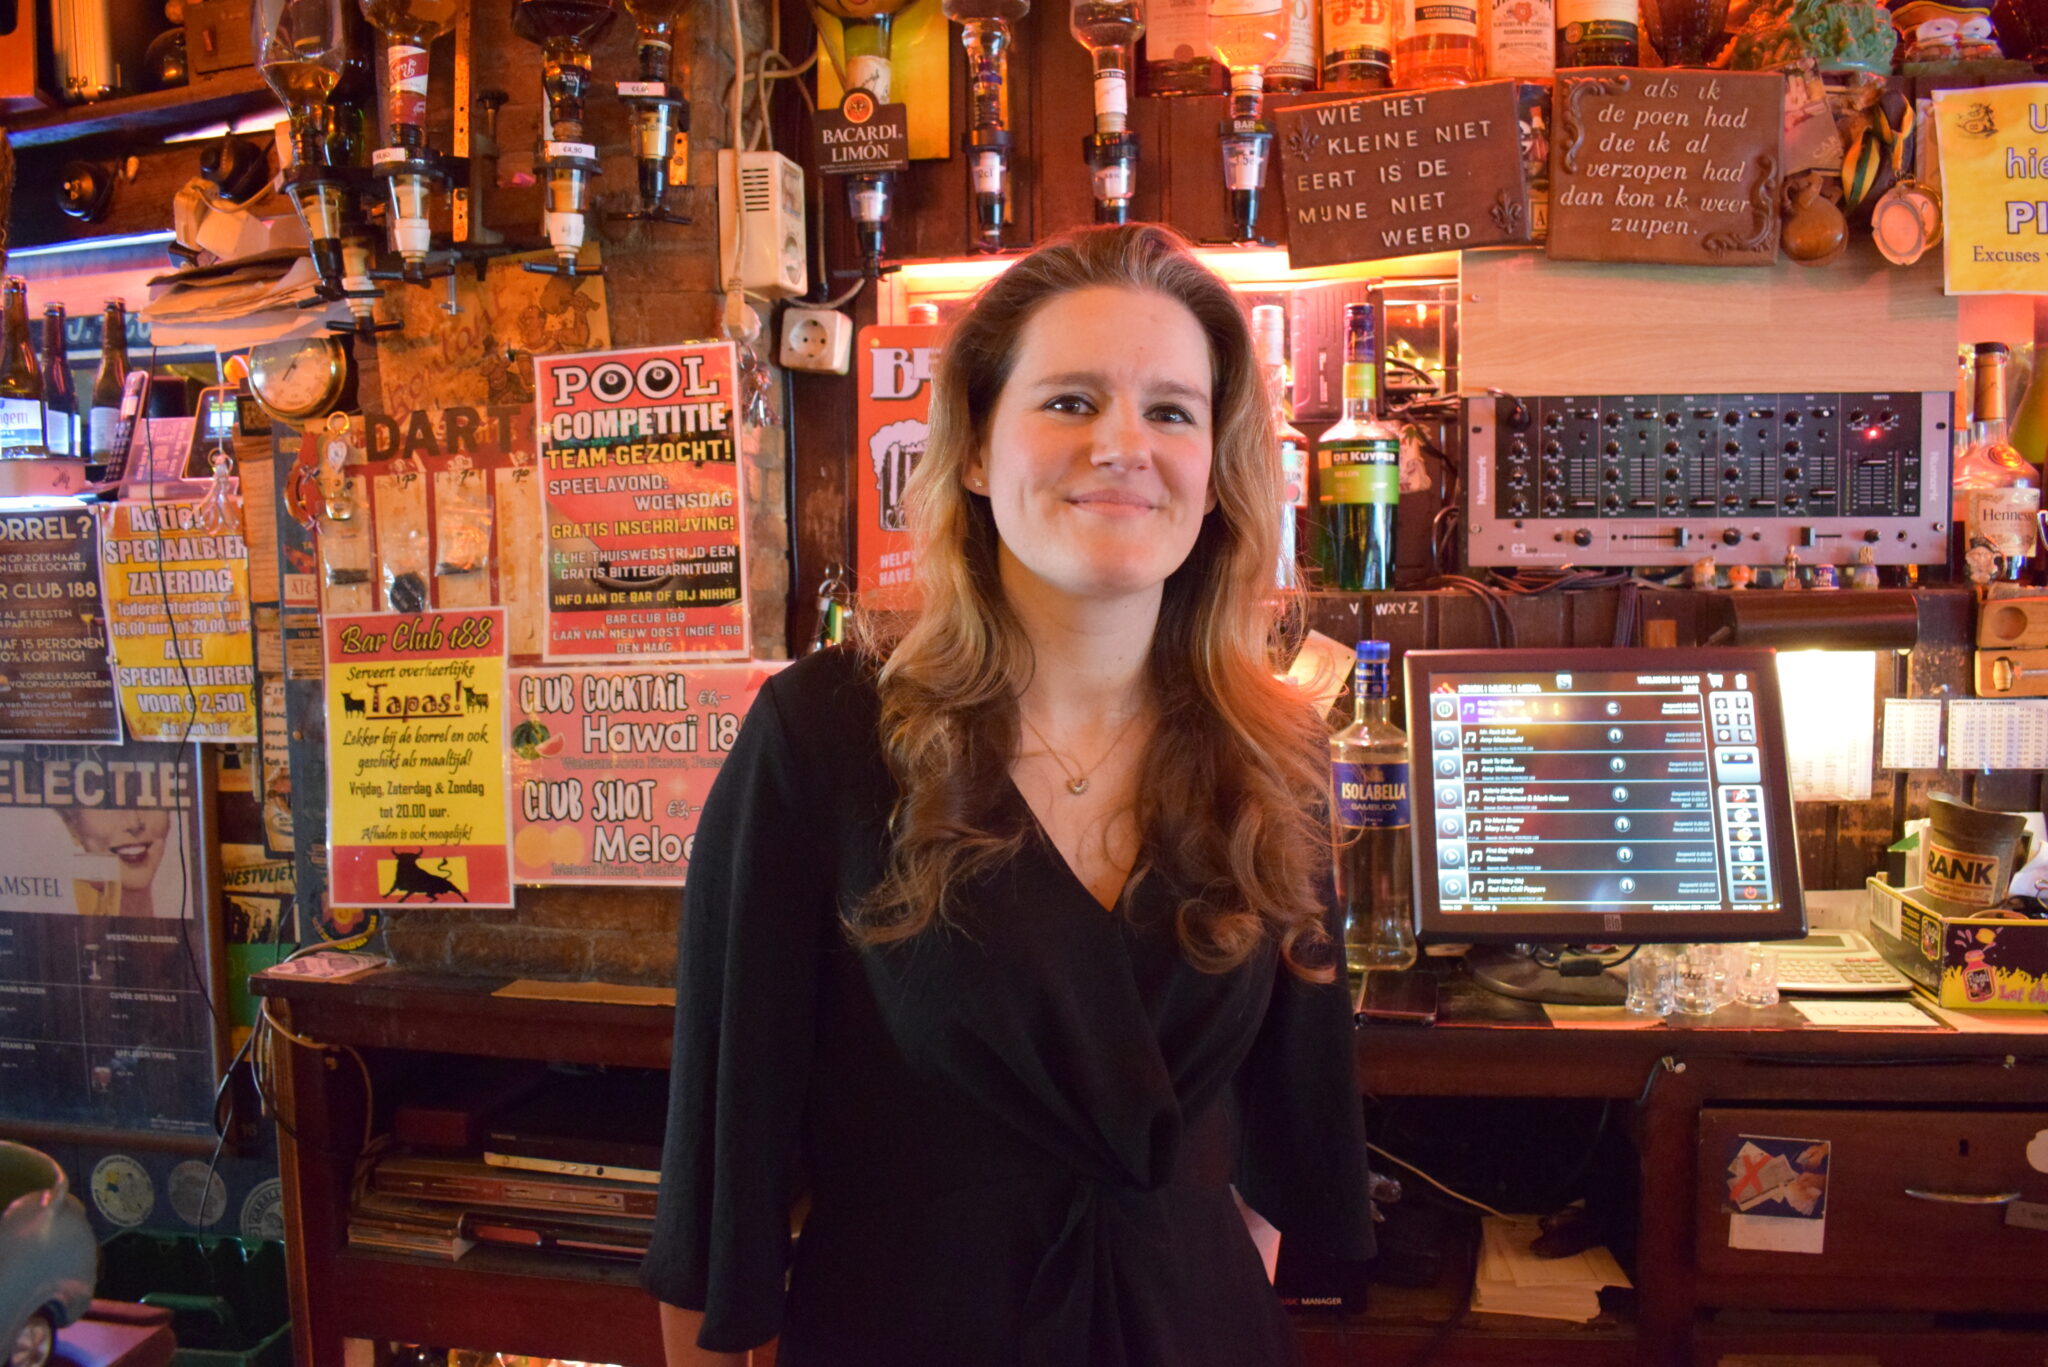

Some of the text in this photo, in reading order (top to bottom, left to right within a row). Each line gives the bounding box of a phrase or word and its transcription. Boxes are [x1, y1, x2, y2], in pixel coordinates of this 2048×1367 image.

[1644, 78, 1679, 99] als
[1316, 97, 1426, 127] WIE HET
[1598, 104, 1749, 130] de poen had
[1233, 120, 1256, 131] BAR
[1328, 120, 1491, 156] KLEINE NIET
[1686, 133, 1710, 153] al
[831, 141, 889, 163] LIMÓN
[1298, 159, 1448, 192] EERT IS DE
[1586, 160, 1746, 185] verzopen had
[1391, 192, 1446, 214] NIET
[1560, 185, 1604, 206] dan
[1614, 184, 1656, 208] kon
[1700, 197, 1750, 213] weer
[1381, 222, 1471, 247] WEERD
[1972, 245, 2041, 263] Excuses
[552, 355, 719, 406] POOL
[552, 401, 727, 442] COMPETITIE
[363, 407, 521, 463] DART
[545, 438, 732, 470] TEAM GEZOCHT!
[1333, 450, 1396, 462] DE KUYPER
[549, 474, 669, 496] SPEELAVOND:
[1476, 455, 1488, 506] Numark
[1929, 450, 1940, 503] Numark
[633, 491, 733, 512] WOENSDAG
[551, 516, 735, 540] GRATIS INSCHRIJVING!
[105, 535, 249, 565] SPECIAALBIER
[591, 546, 706, 563] THUISWEDSTRIJD
[709, 545, 736, 559] EEN
[128, 567, 234, 597] ZATERDAG
[560, 562, 734, 581] GRATIS BITTERGARNITUUR!
[879, 569, 912, 586] HAVE
[13, 581, 98, 600] CLUB 188
[554, 594, 582, 606] INFO
[585, 593, 607, 605] AAN
[610, 592, 626, 604] DE
[629, 592, 653, 603] BAR
[656, 590, 671, 602] OF
[675, 589, 696, 601] BIJ
[161, 601, 216, 619] zaterdag
[605, 612, 686, 625] BAR CLUB 188
[113, 621, 146, 637] 16.00
[147, 621, 170, 636] uur
[191, 619, 226, 635] 20.00
[340, 625, 387, 655] Bar
[391, 616, 444, 652] Club
[448, 615, 493, 650] 188
[552, 627, 582, 641] LAAN
[584, 628, 606, 640] VAN
[609, 627, 647, 640] NIEUW
[650, 626, 681, 638] OOST
[720, 625, 742, 636] 188
[21, 637, 106, 650] 15 PERSONEN
[164, 639, 204, 661] ALLE
[616, 642, 673, 654] DEN HAAG
[23, 650, 86, 662] KORTING!
[120, 665, 255, 688] SPECIAALBIEREN
[346, 659, 476, 681] Serveert overheerlijke
[137, 693, 181, 714] VOOR
[200, 692, 247, 714] 2,50!
[366, 680, 464, 724] Tapas!
[519, 673, 575, 714] CLUB
[342, 723, 489, 752] Lekker bij de borrel en ook
[581, 713, 750, 754] Hawaï 18
[354, 750, 401, 777] geschikt
[401, 750, 417, 768] als
[386, 780, 432, 798] Zaterdag
[434, 781, 445, 794] &
[447, 779, 486, 797] Zondag
[1341, 782, 1408, 801] ISOLABELLA
[379, 803, 427, 819] tot 20.00
[522, 778, 583, 822] CLUB
[591, 778, 658, 823] SHOT
[360, 824, 399, 843] Afhalen
[408, 825, 430, 842] ook
[1301, 1297, 1342, 1306] MANAGER
